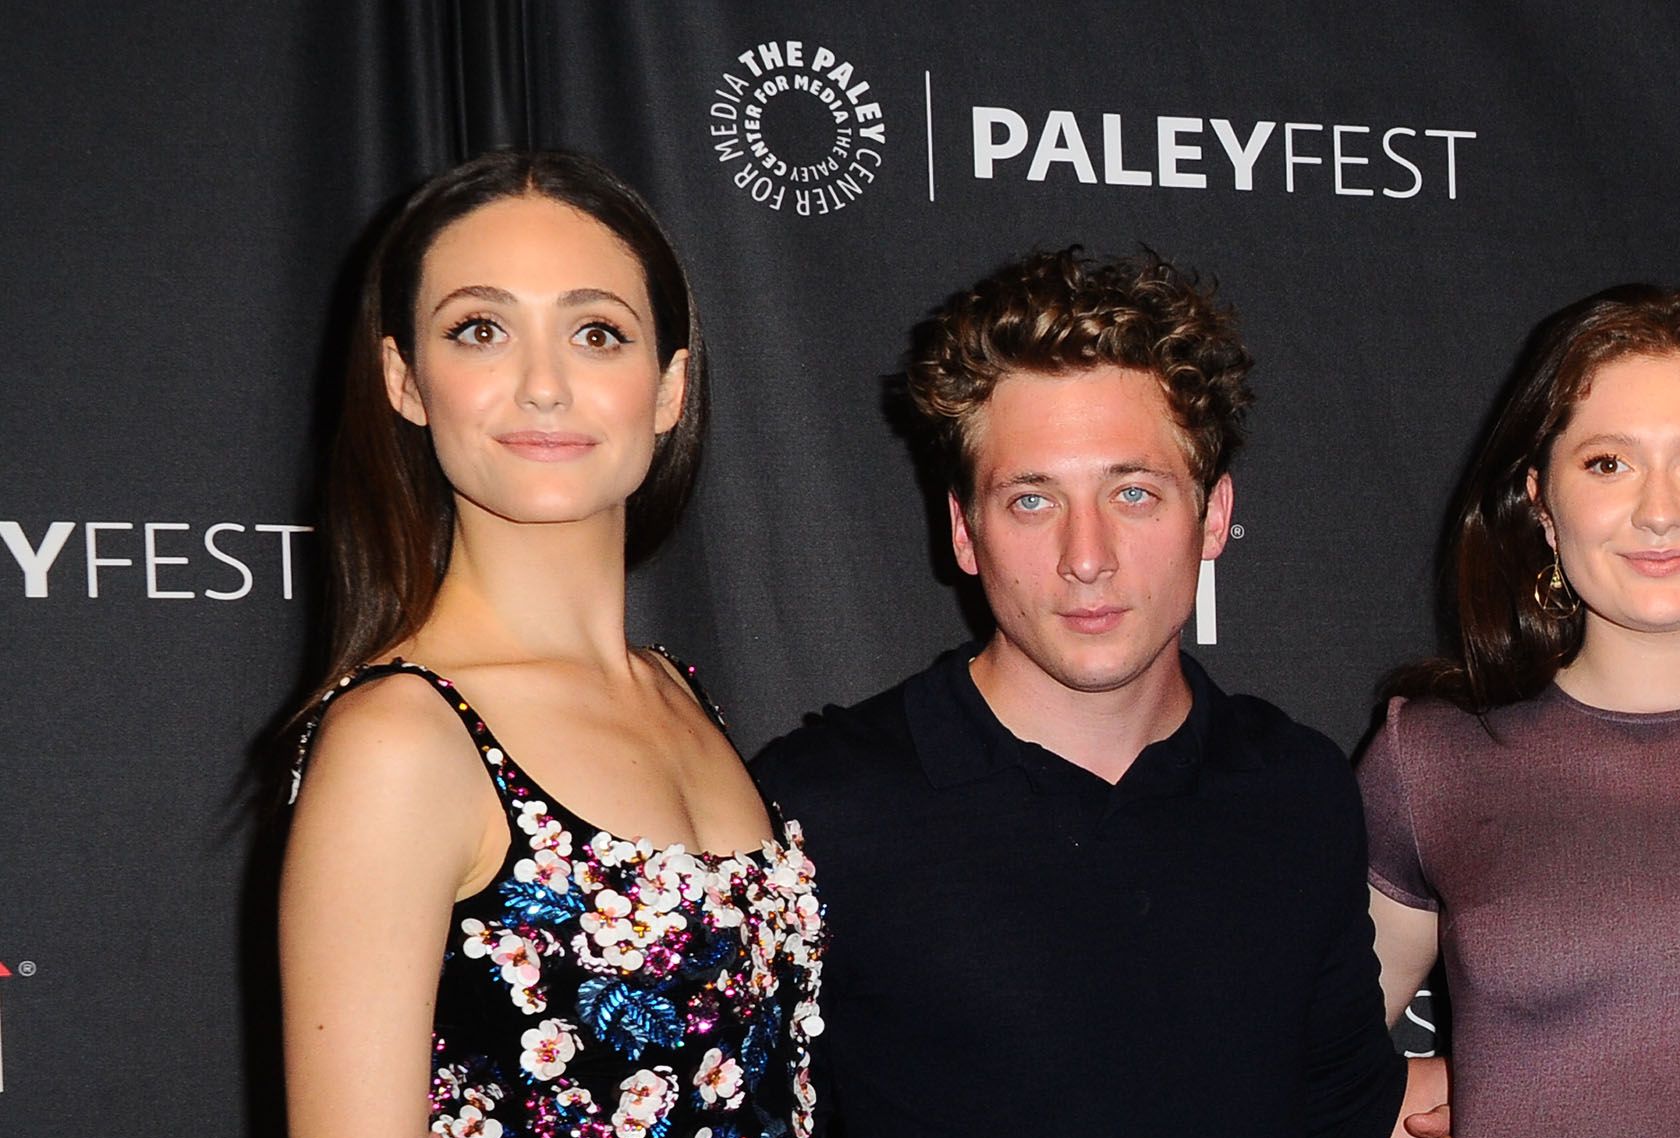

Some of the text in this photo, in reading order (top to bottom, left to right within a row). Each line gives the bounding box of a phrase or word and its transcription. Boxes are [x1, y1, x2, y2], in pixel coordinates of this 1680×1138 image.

[710, 41, 886, 216] THE PALEY CENTER FOR MEDIA
[745, 75, 852, 182] THE PALEY CENTER FOR MEDIA
[973, 107, 1476, 199] PALEYFEST
